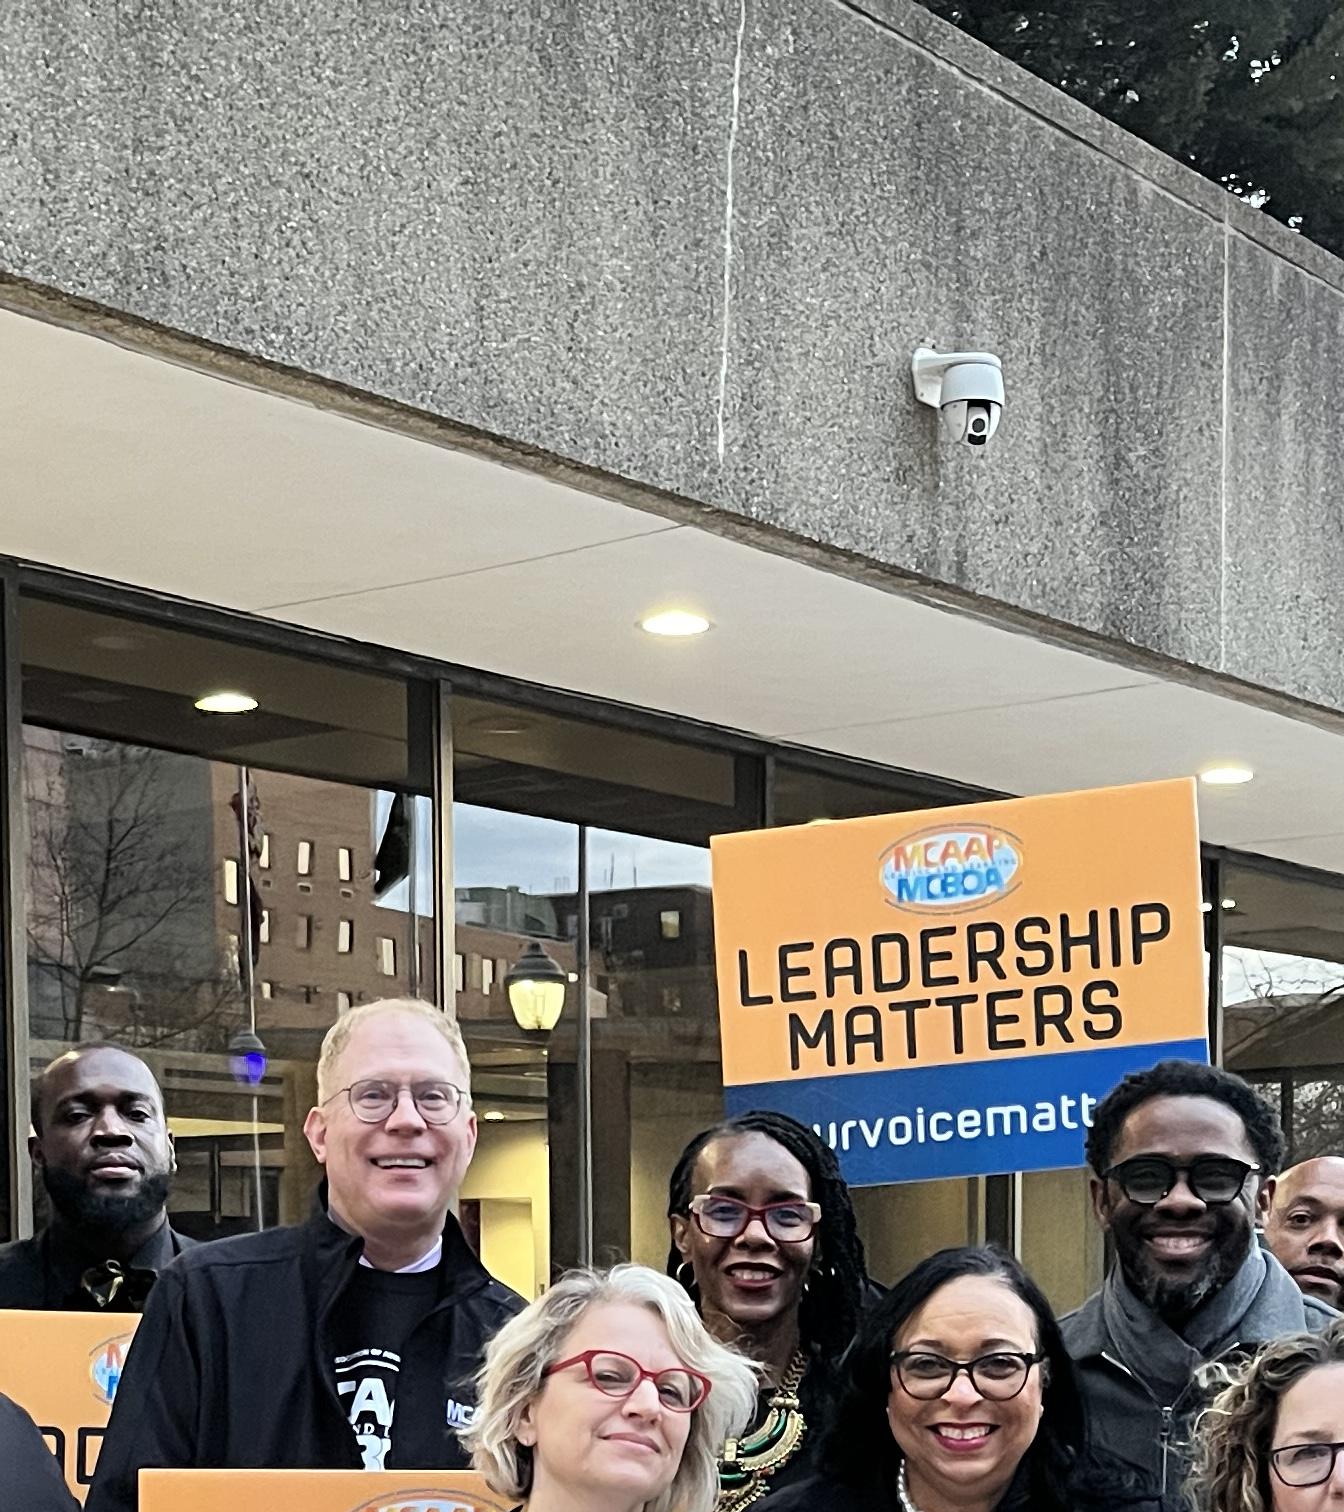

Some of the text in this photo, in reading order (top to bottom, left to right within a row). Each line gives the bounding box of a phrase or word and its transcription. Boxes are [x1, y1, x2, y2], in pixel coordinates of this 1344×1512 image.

[893, 834, 1006, 871] MCAAP
[897, 868, 1003, 904] MCBOA
[738, 902, 1171, 1008] LEADERSHIP
[789, 980, 1123, 1071] MATTERS
[813, 1092, 1096, 1151] urvoicematt
